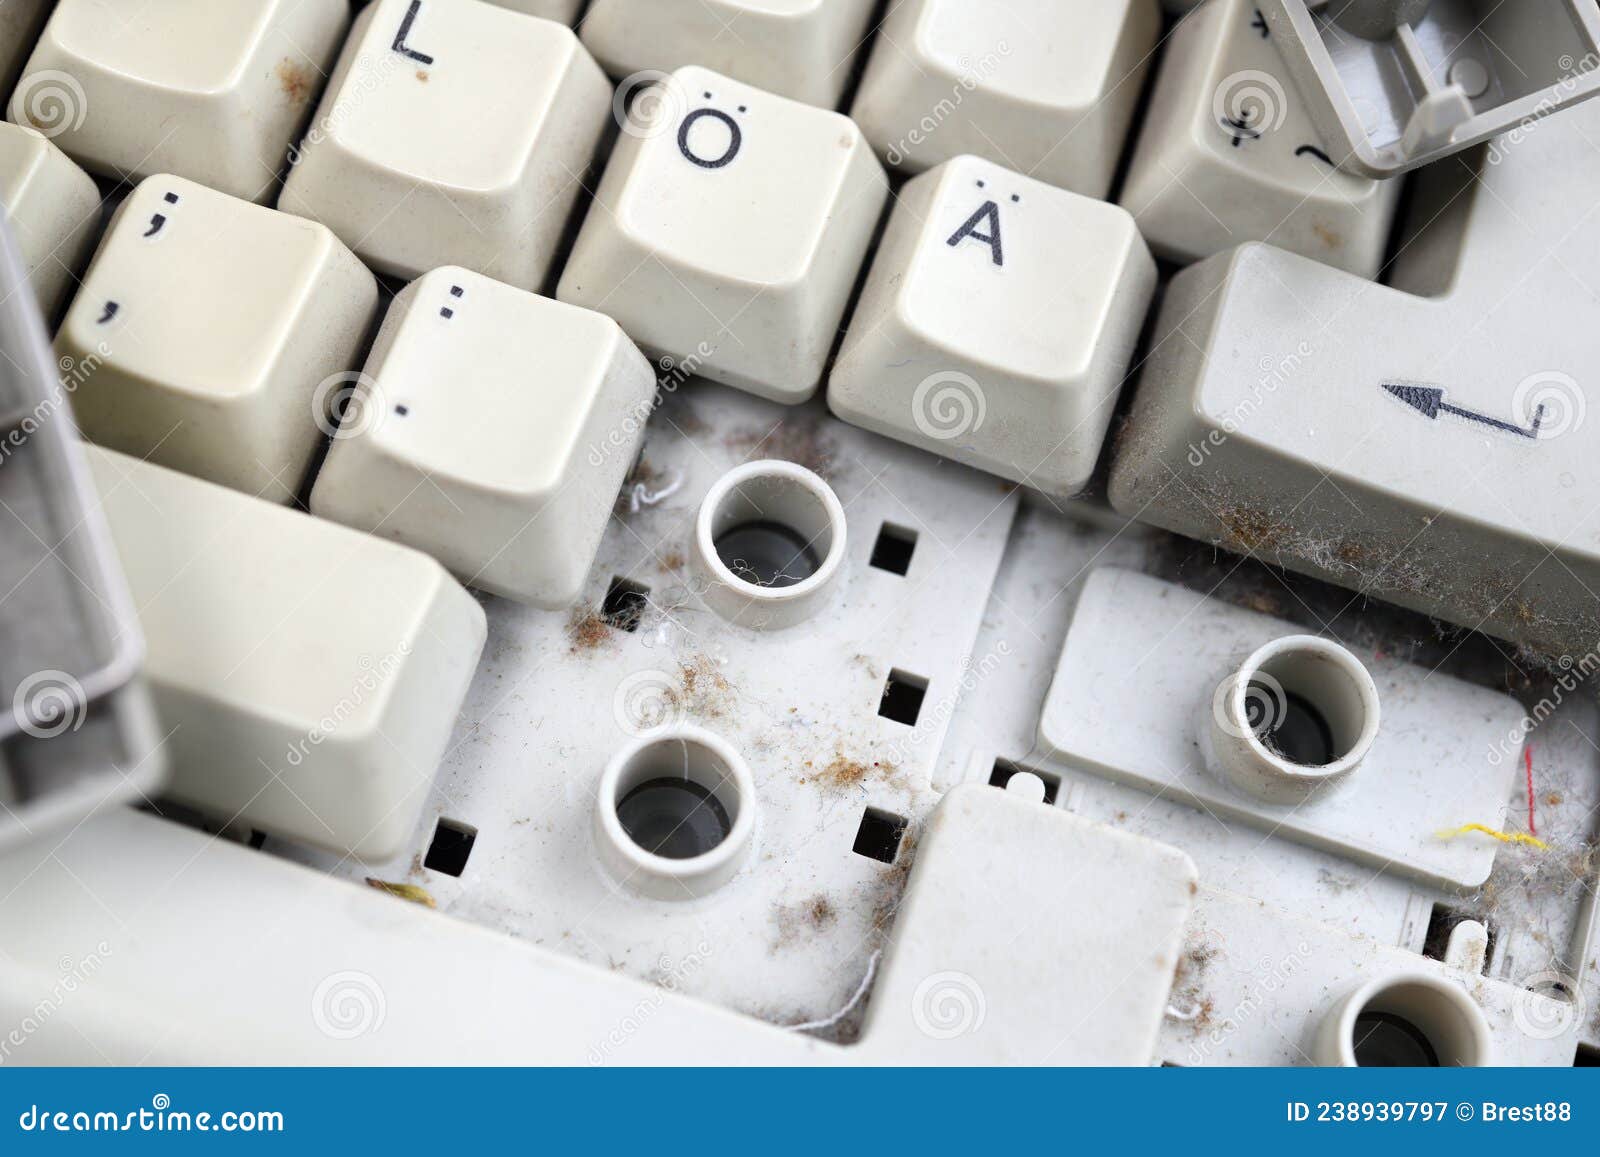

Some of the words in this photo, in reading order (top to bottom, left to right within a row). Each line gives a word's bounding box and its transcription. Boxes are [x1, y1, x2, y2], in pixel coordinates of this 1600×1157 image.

[391, 0, 434, 65] L
[677, 91, 747, 169] Ö
[142, 191, 180, 238] ;
[946, 180, 1020, 267] Ä
[439, 284, 465, 320] :
